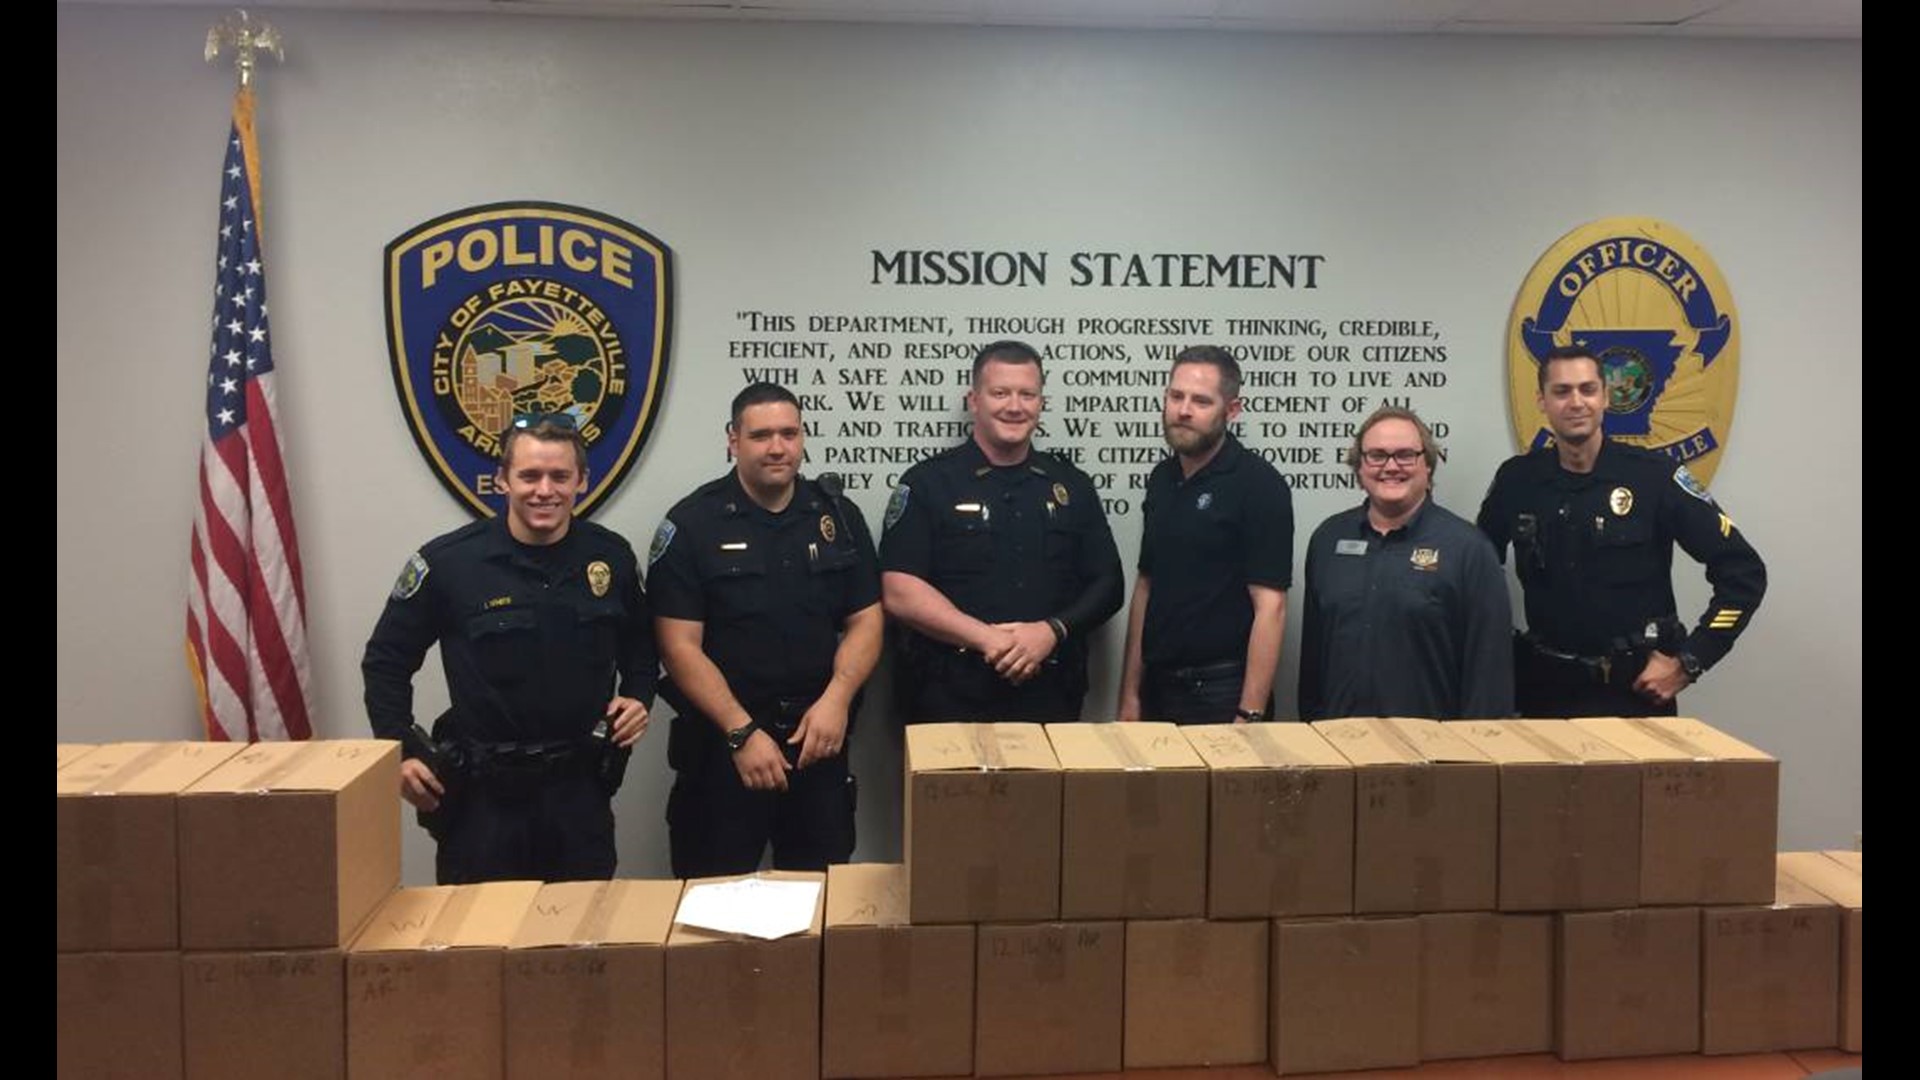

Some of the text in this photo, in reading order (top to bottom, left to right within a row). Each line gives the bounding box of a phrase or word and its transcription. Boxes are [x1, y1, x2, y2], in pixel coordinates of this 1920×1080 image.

[421, 225, 634, 290] POLICE
[871, 250, 1326, 289] MISSION STATEMENT
[1559, 240, 1698, 304] OFFICER
[432, 278, 626, 396] CITY OF FAYETTEVILLE
[808, 316, 954, 337] DEPARTMENT,
[965, 317, 1065, 335] THROUGH
[1077, 318, 1214, 336] PROGRESSIVE
[1225, 319, 1329, 339] THINKING,
[1338, 320, 1441, 340] CREDIBLE,
[728, 342, 836, 362] EFFICIENT,
[849, 342, 892, 360] AND
[1042, 345, 1132, 364] ACTIONS,
[1307, 346, 1350, 362] OUR
[1362, 346, 1448, 363] CITIZENS
[742, 369, 799, 386] WITH
[811, 370, 827, 386] A
[838, 370, 888, 386] SAFE
[900, 370, 944, 387] AND
[1062, 371, 1169, 388] COMMUNIT
[1309, 372, 1337, 388] TO
[1348, 372, 1392, 388] LIVE
[1404, 373, 1447, 388] AND
[846, 391, 886, 411] WE
[898, 396, 950, 412] WILL
[1065, 396, 1163, 413] IMPARTIA
[1341, 397, 1367, 413] OF
[837, 421, 882, 437] AND
[1066, 418, 1102, 437] WE
[1115, 422, 1164, 438] WILL
[1260, 422, 1287, 438] TO
[1098, 447, 1172, 463] CITIZEN
[1092, 473, 1117, 489] OF
[1103, 499, 1129, 515] TO
